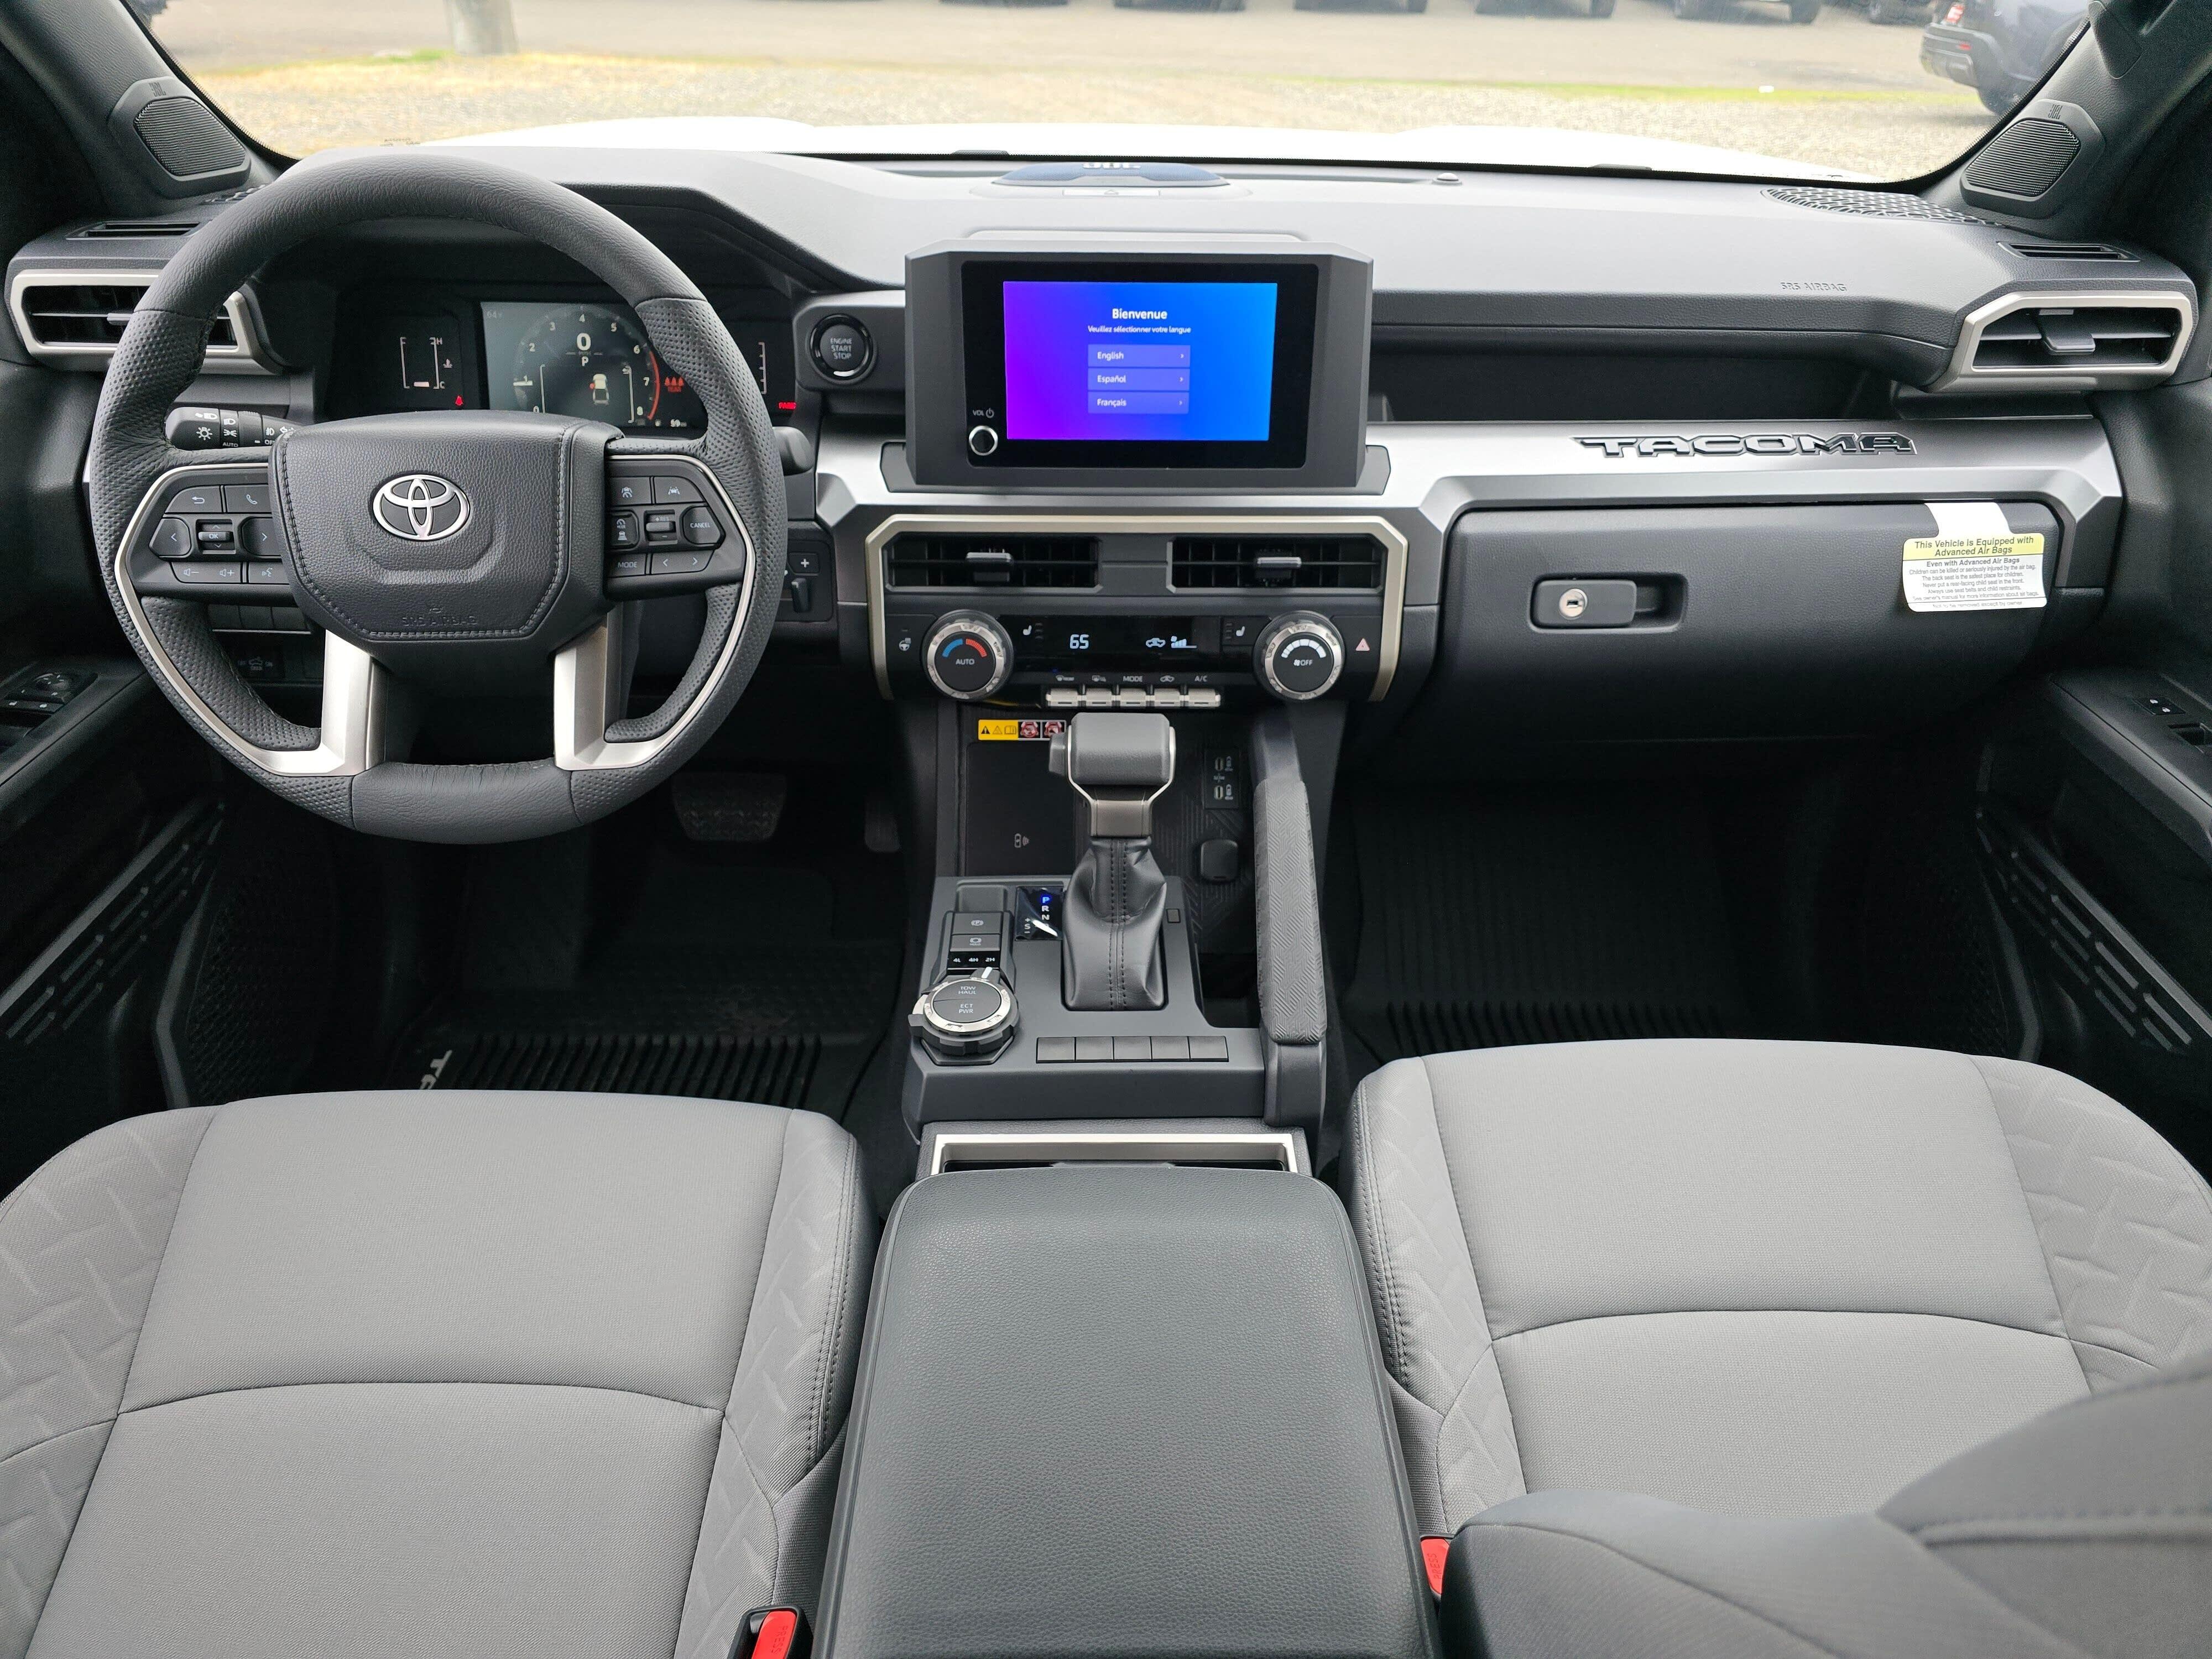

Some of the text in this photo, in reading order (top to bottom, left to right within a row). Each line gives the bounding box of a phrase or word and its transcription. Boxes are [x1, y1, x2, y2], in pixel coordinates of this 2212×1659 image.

[149, 82, 166, 97] JBL
[2048, 104, 2063, 119] JBL
[1804, 282, 1847, 291] AIRBAG
[579, 314, 586, 322] 4
[1112, 308, 1167, 319] Bienvenue
[550, 322, 556, 331] 3
[611, 322, 617, 332] 5
[1169, 326, 1191, 335] langue
[577, 332, 591, 351] 0
[529, 342, 535, 352] 2
[634, 345, 640, 354] 6
[1097, 351, 1124, 361] English
[582, 356, 589, 367] P
[643, 377, 650, 386] 7
[1097, 374, 1126, 384] Español
[1097, 398, 1126, 408] Français
[1569, 431, 1917, 457] TACOMA
[1935, 539, 1964, 547] Vehicle
[1976, 537, 2015, 547] Equipped
[1934, 547, 1976, 556] Advanced
[1992, 546, 2012, 555] Bags
[1070, 634, 1089, 649] 65
[1427, 1552, 1442, 1579] PRESS
